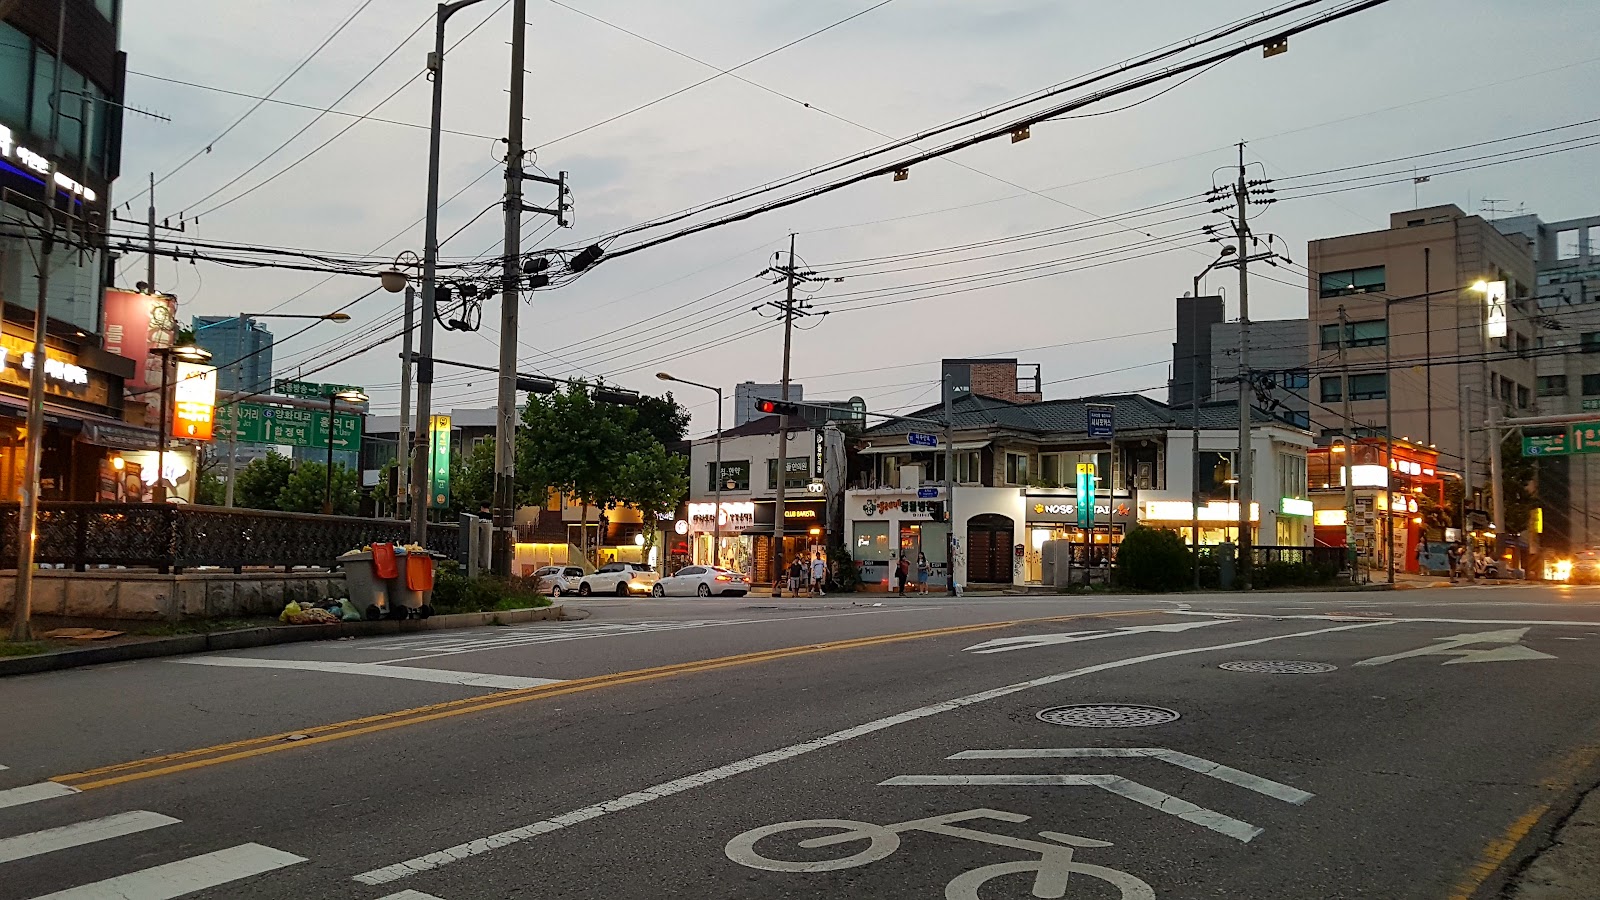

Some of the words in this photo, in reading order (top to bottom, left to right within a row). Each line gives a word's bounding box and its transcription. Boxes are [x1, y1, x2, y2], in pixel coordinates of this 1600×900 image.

[275, 409, 311, 421] 양화대교
[274, 426, 305, 438] 합정역
[784, 510, 797, 518] CLUB
[1045, 504, 1074, 514] NOSE
